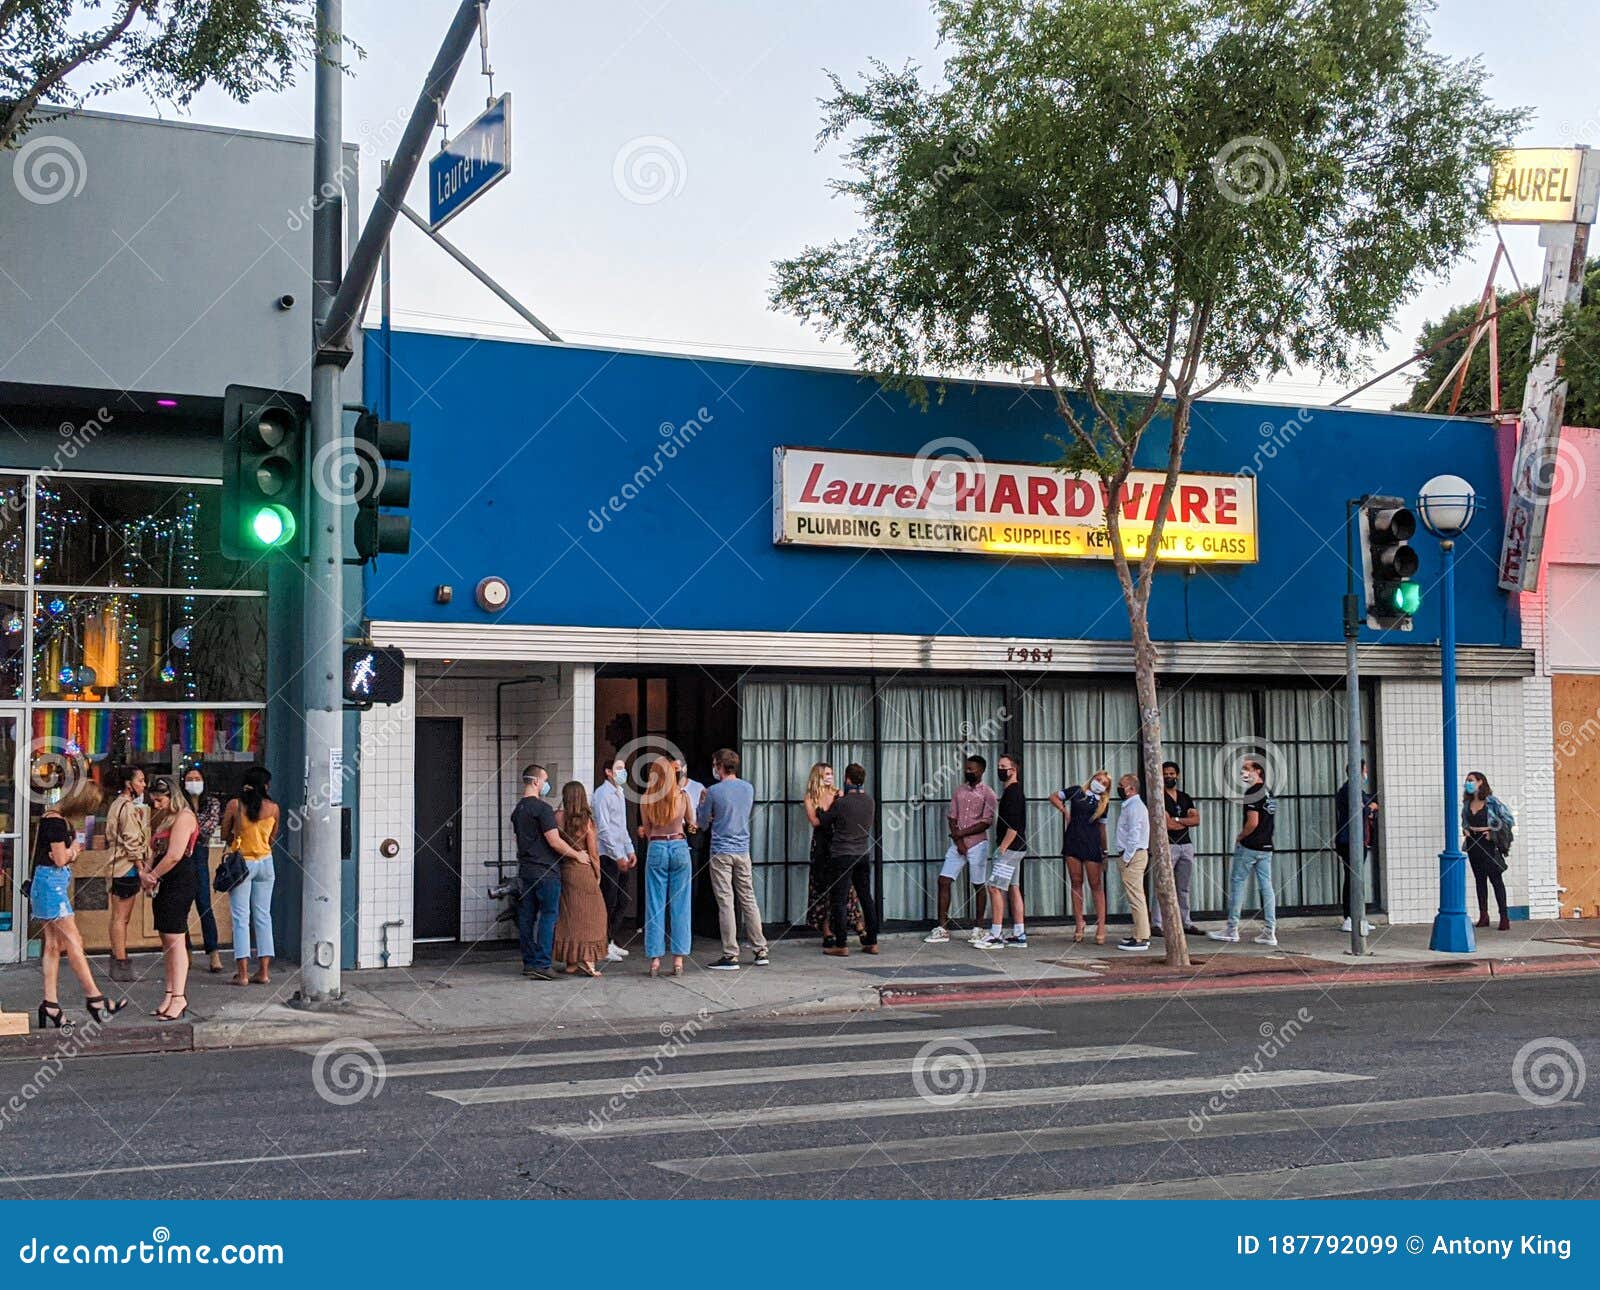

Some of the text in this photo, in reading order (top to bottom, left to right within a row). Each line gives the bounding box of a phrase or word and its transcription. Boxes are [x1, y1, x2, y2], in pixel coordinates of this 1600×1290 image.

[437, 147, 475, 205] Laurel
[1490, 167, 1572, 203] LAUREL
[799, 463, 1237, 525] Laurel HARDWARE
[797, 516, 1246, 554] PLUMBING & ELECTRICAL SUPPLIES KEY PNT & GLASS
